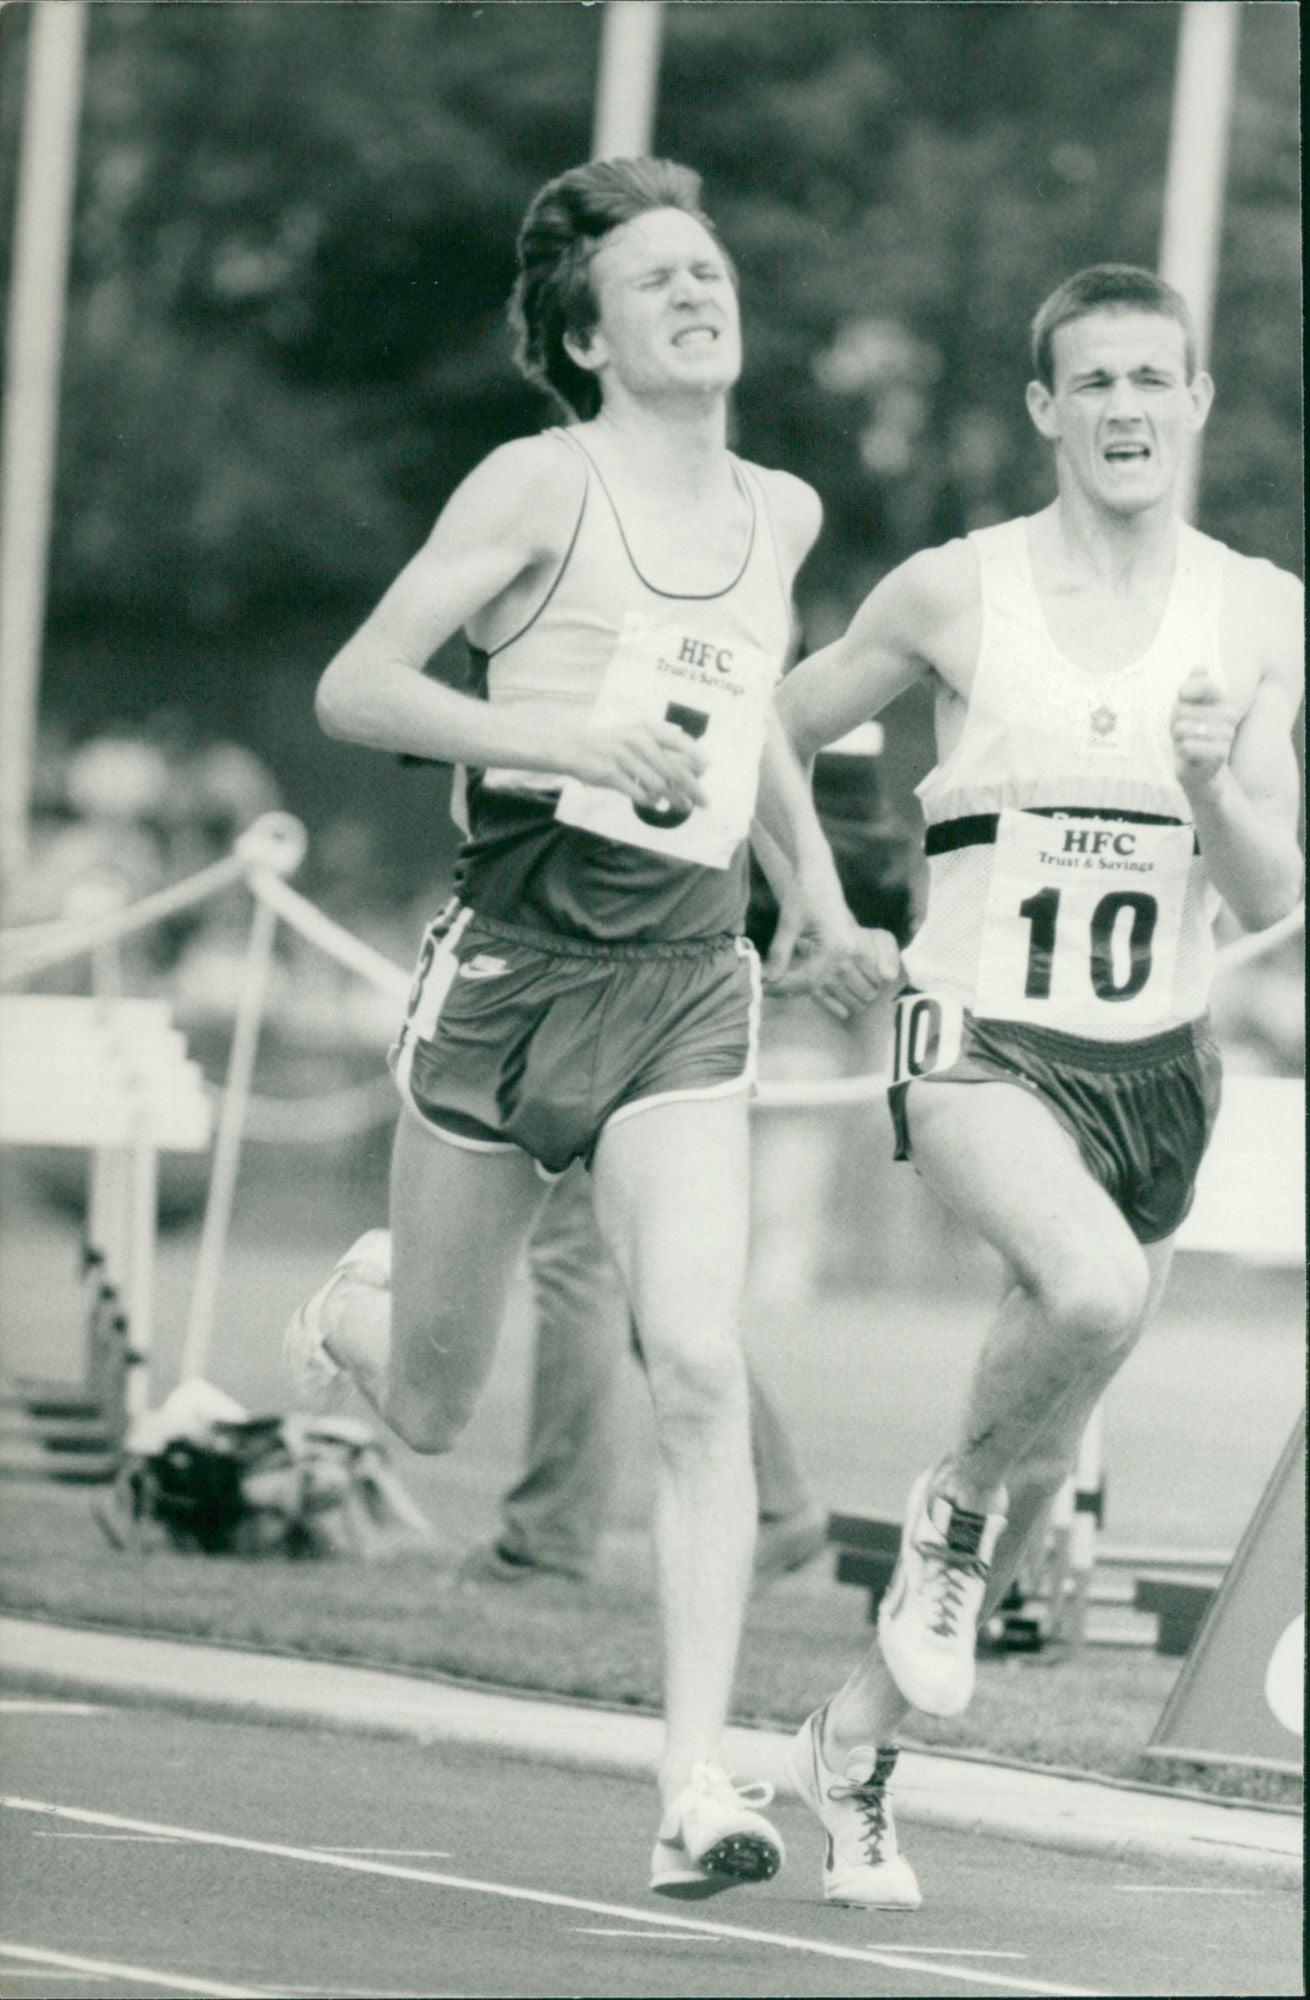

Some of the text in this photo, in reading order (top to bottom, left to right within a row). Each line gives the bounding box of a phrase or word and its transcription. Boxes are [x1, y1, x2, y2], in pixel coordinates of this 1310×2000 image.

[678, 636, 734, 673] HFC
[1062, 829, 1137, 857] HFC
[1039, 851, 1155, 873] Trust & Savings
[1019, 886, 1158, 1003] 10
[894, 999, 942, 1084] 10
